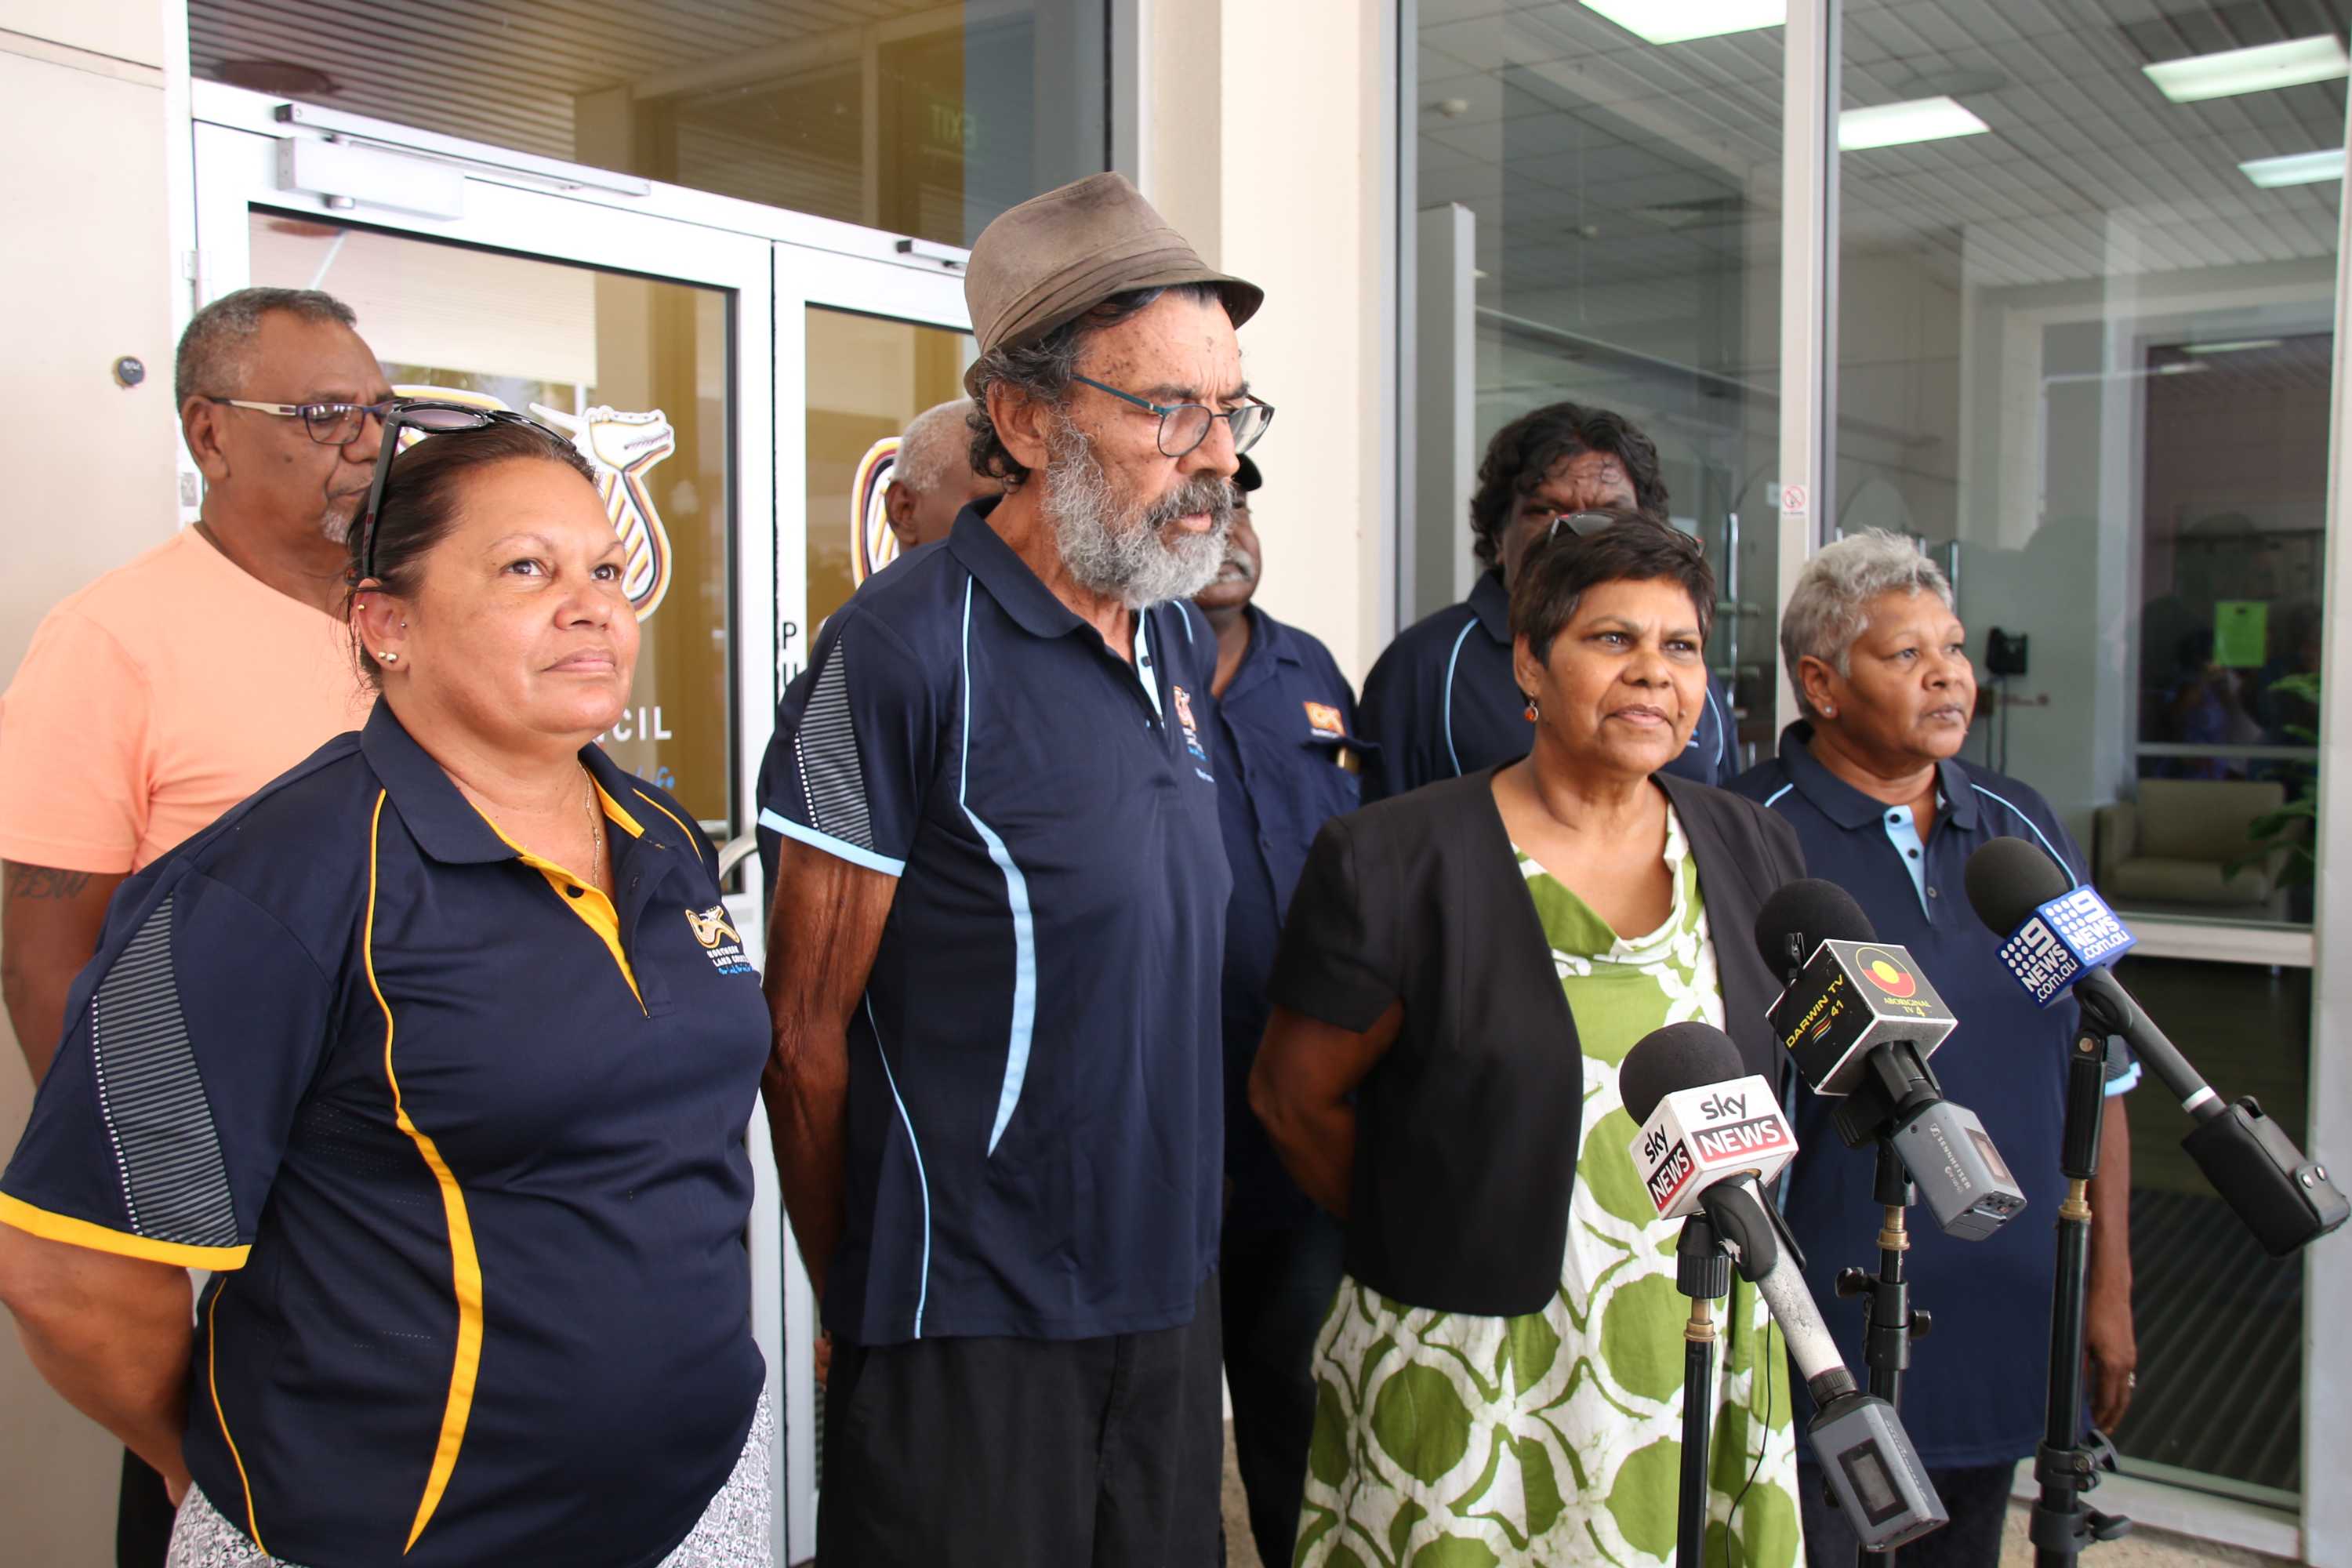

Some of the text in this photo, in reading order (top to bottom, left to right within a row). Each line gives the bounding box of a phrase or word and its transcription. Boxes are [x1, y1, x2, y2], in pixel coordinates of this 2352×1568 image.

[592, 706, 672, 742] CIL
[2067, 890, 2107, 923] 9
[2020, 916, 2056, 957] 9
[2067, 916, 2120, 949] NEWS
[2083, 930, 2130, 960] .com.au
[2021, 944, 2068, 993] NEWS
[2037, 958, 2079, 1002] .com.au
[1785, 974, 1845, 1048] DARWIN TV
[1831, 1000, 1845, 1017] 41
[1700, 1093, 1746, 1120] sky
[1644, 1123, 1669, 1165] sky
[1698, 1120, 1781, 1158] NEWS
[1651, 1148, 1690, 1205] NEWS
